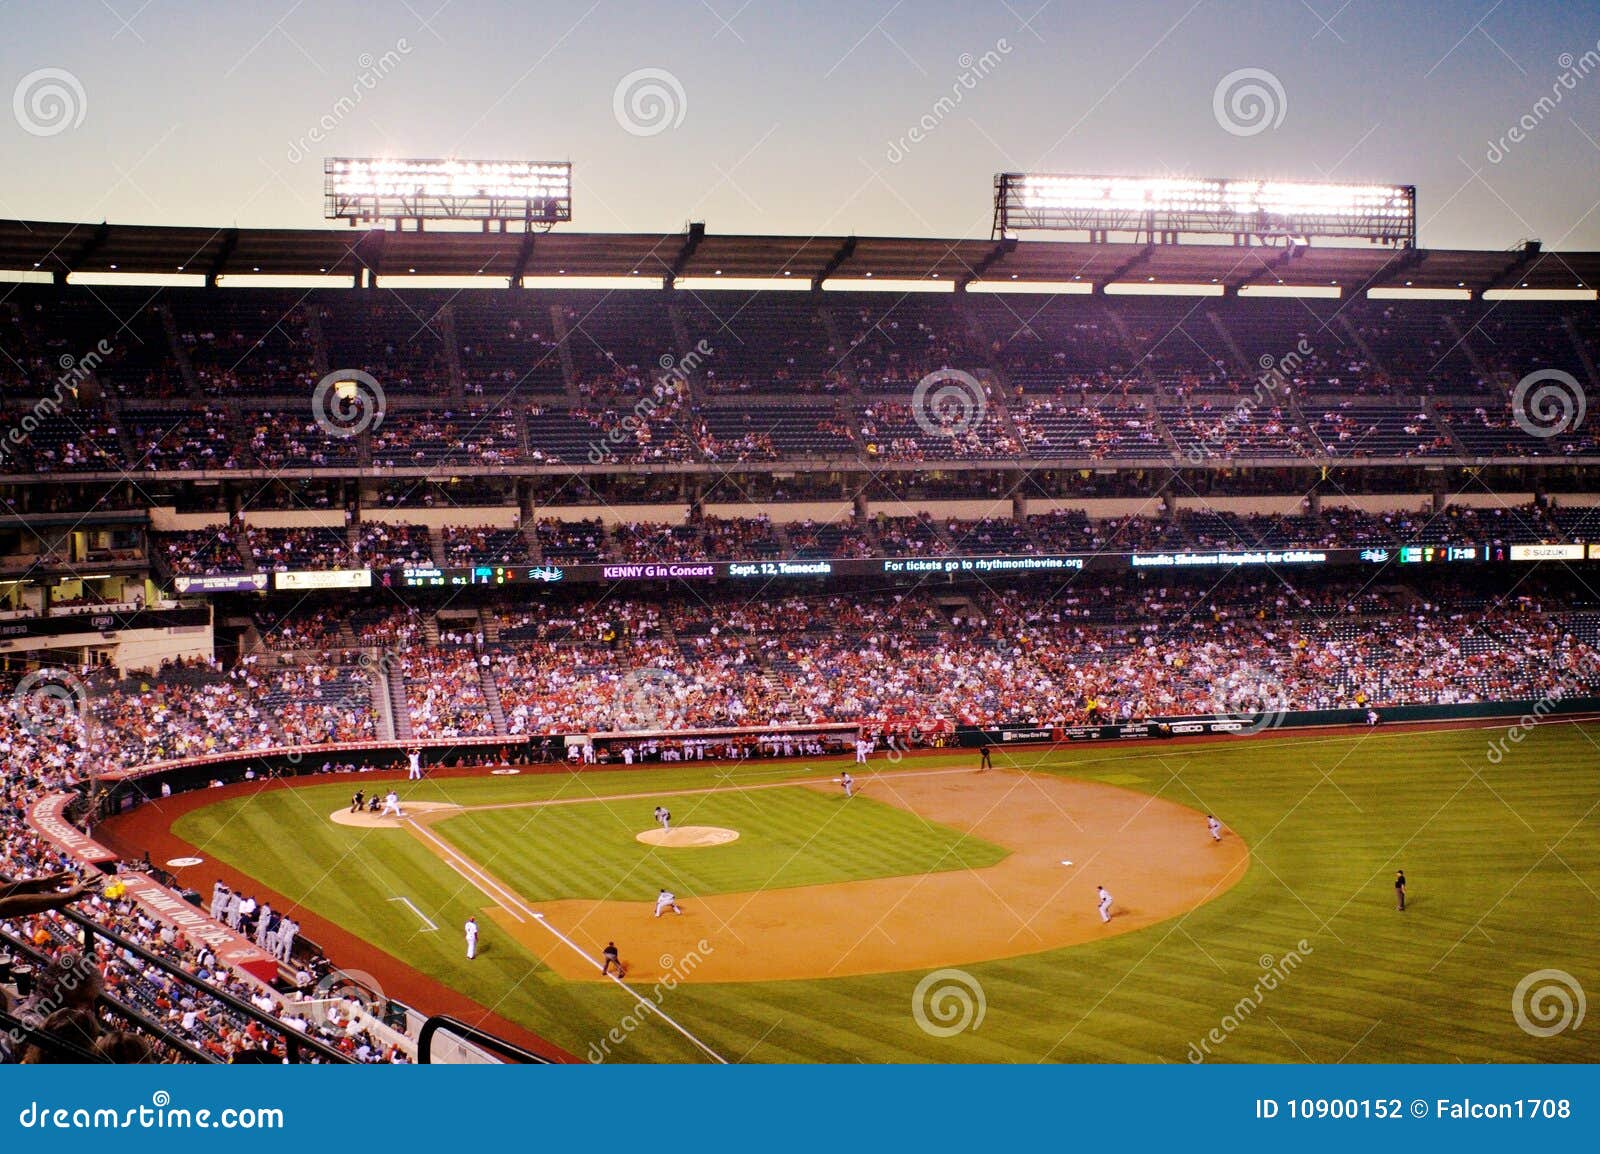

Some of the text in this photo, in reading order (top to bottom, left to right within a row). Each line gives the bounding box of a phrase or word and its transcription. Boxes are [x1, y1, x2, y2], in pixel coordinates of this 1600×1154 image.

[1533, 548, 1568, 557] SUZUKI
[729, 561, 831, 577] Sept. 12, Temecula
[884, 558, 1084, 572] For tickets go to rhythmonthevine.org
[603, 565, 714, 578] KENNY G in Concert
[1172, 724, 1204, 734] GEICO
[1210, 723, 1242, 732] GEICO
